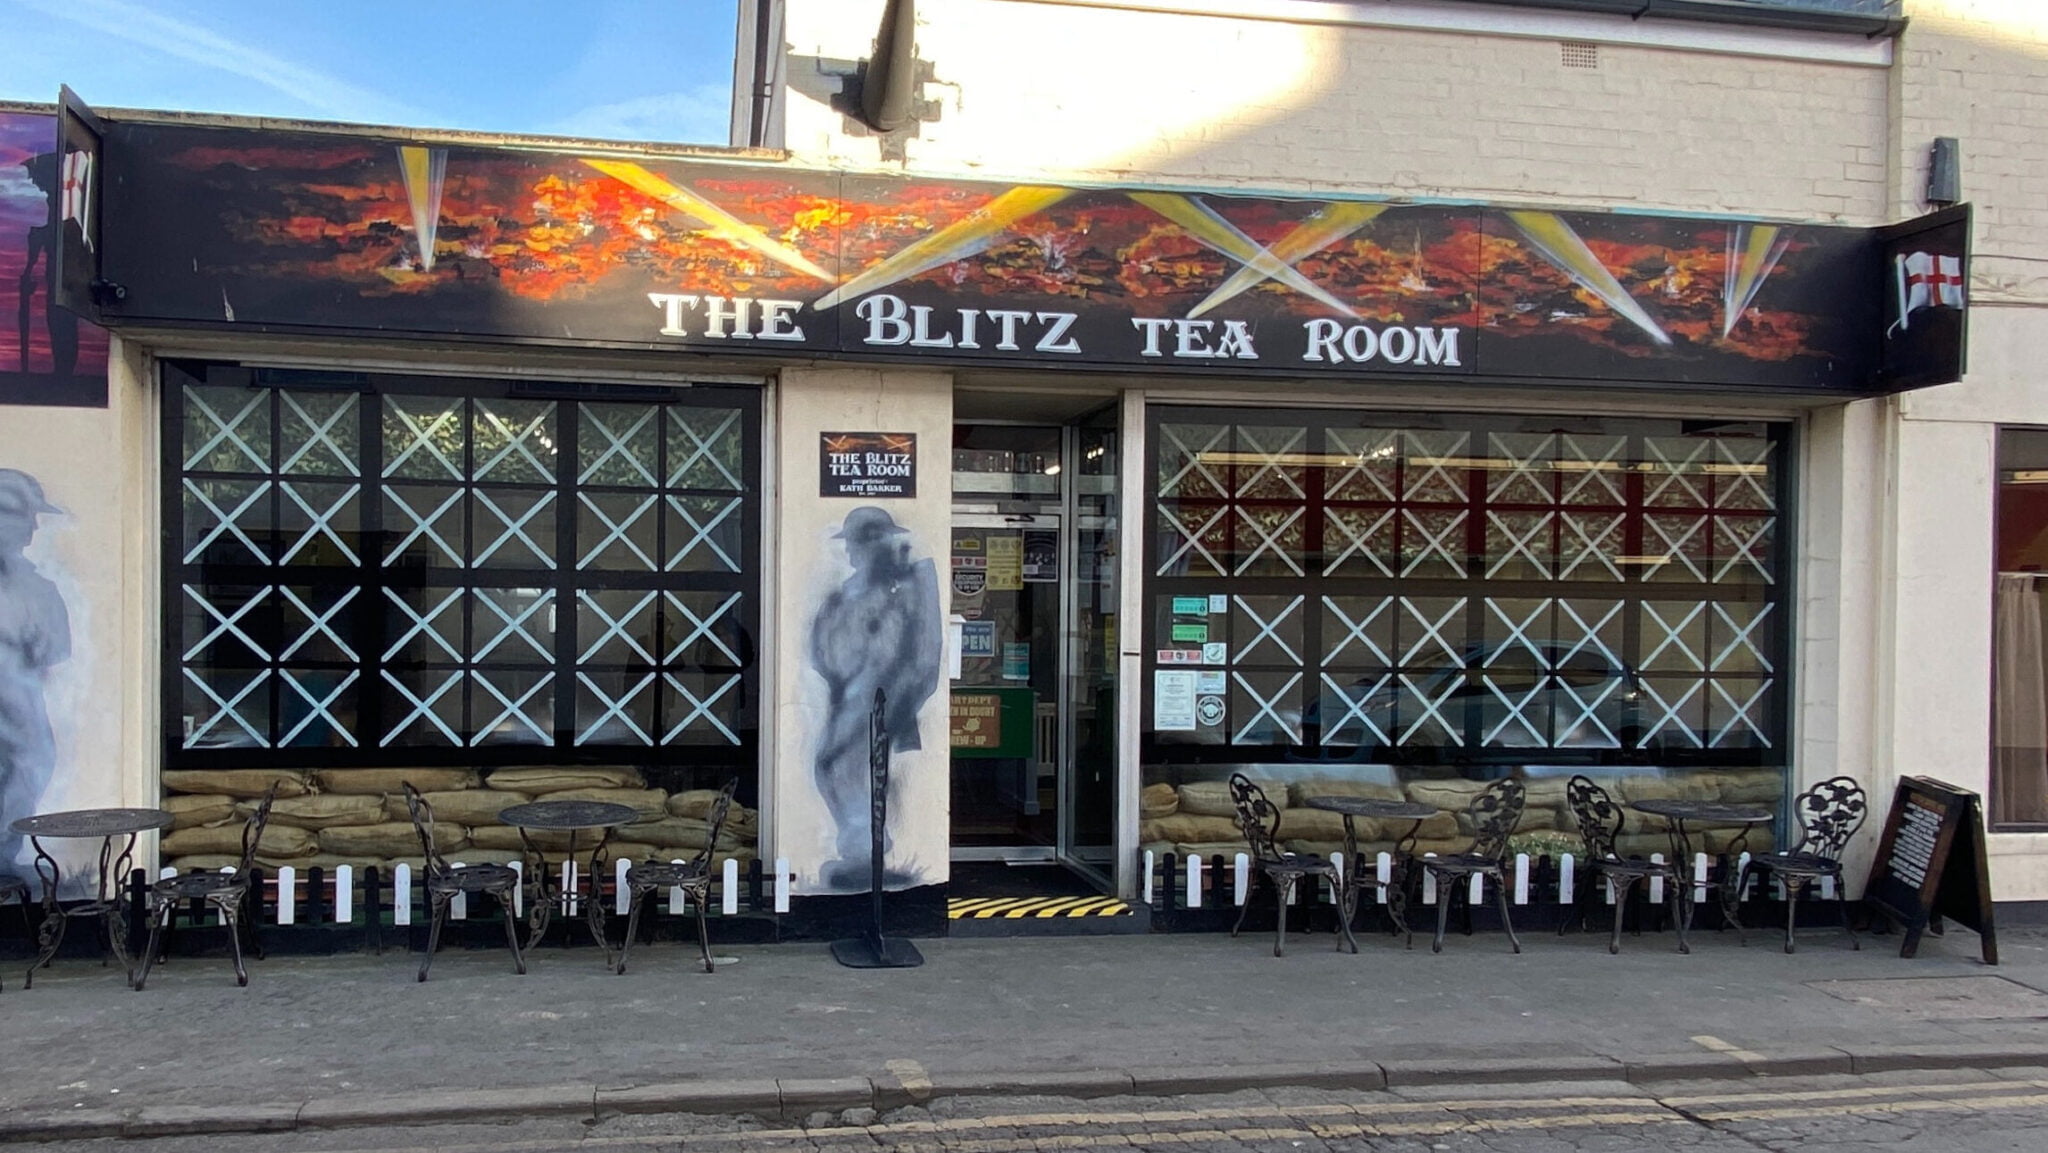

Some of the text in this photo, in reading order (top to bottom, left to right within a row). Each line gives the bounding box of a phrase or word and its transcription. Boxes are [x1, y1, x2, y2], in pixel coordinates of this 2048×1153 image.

[648, 292, 1461, 367] THE BLITZ TEA ROOM
[829, 452, 911, 464] THE BLITZ
[829, 464, 910, 476] TEA ROOM
[962, 635, 991, 650] PEN
